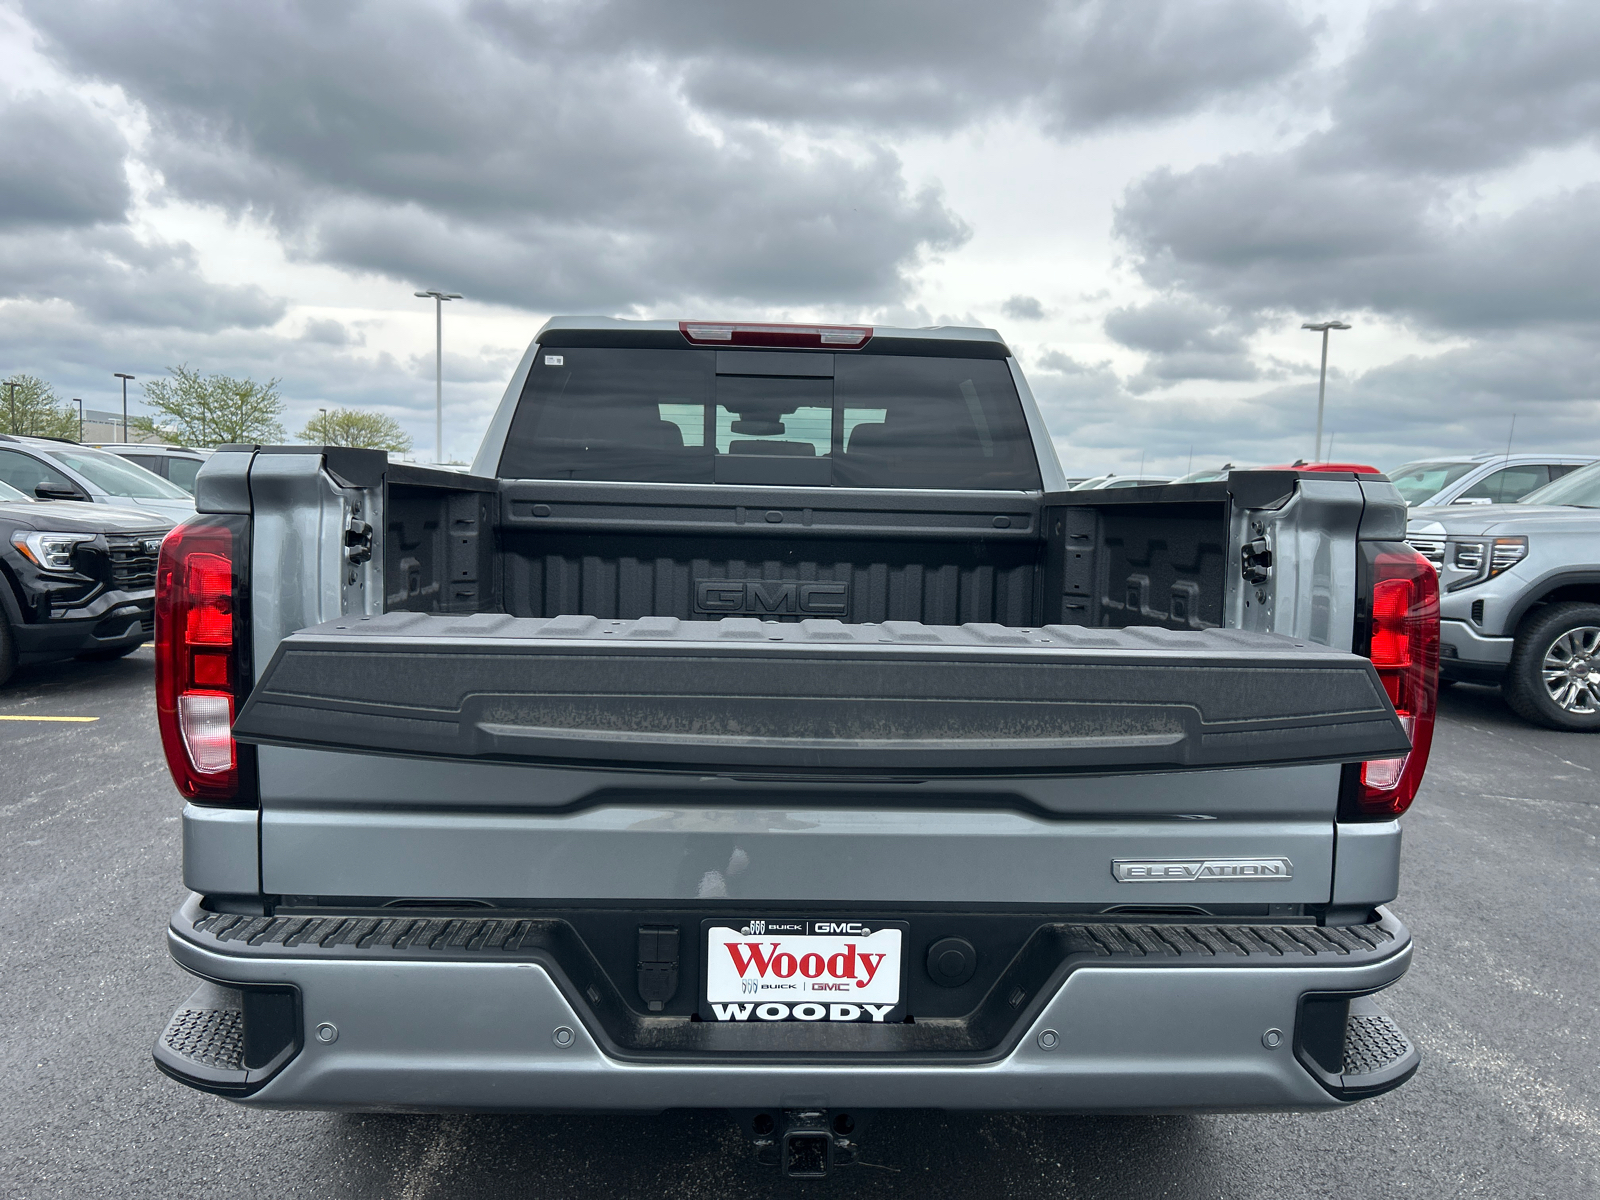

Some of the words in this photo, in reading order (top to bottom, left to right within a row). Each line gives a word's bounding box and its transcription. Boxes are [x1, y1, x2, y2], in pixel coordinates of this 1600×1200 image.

[697, 582, 846, 613] GMC
[1126, 863, 1280, 877] ELEVATION
[814, 922, 863, 934] GMC
[723, 942, 887, 989] Woody
[811, 982, 850, 992] GMC
[711, 1002, 896, 1022] WOODY
